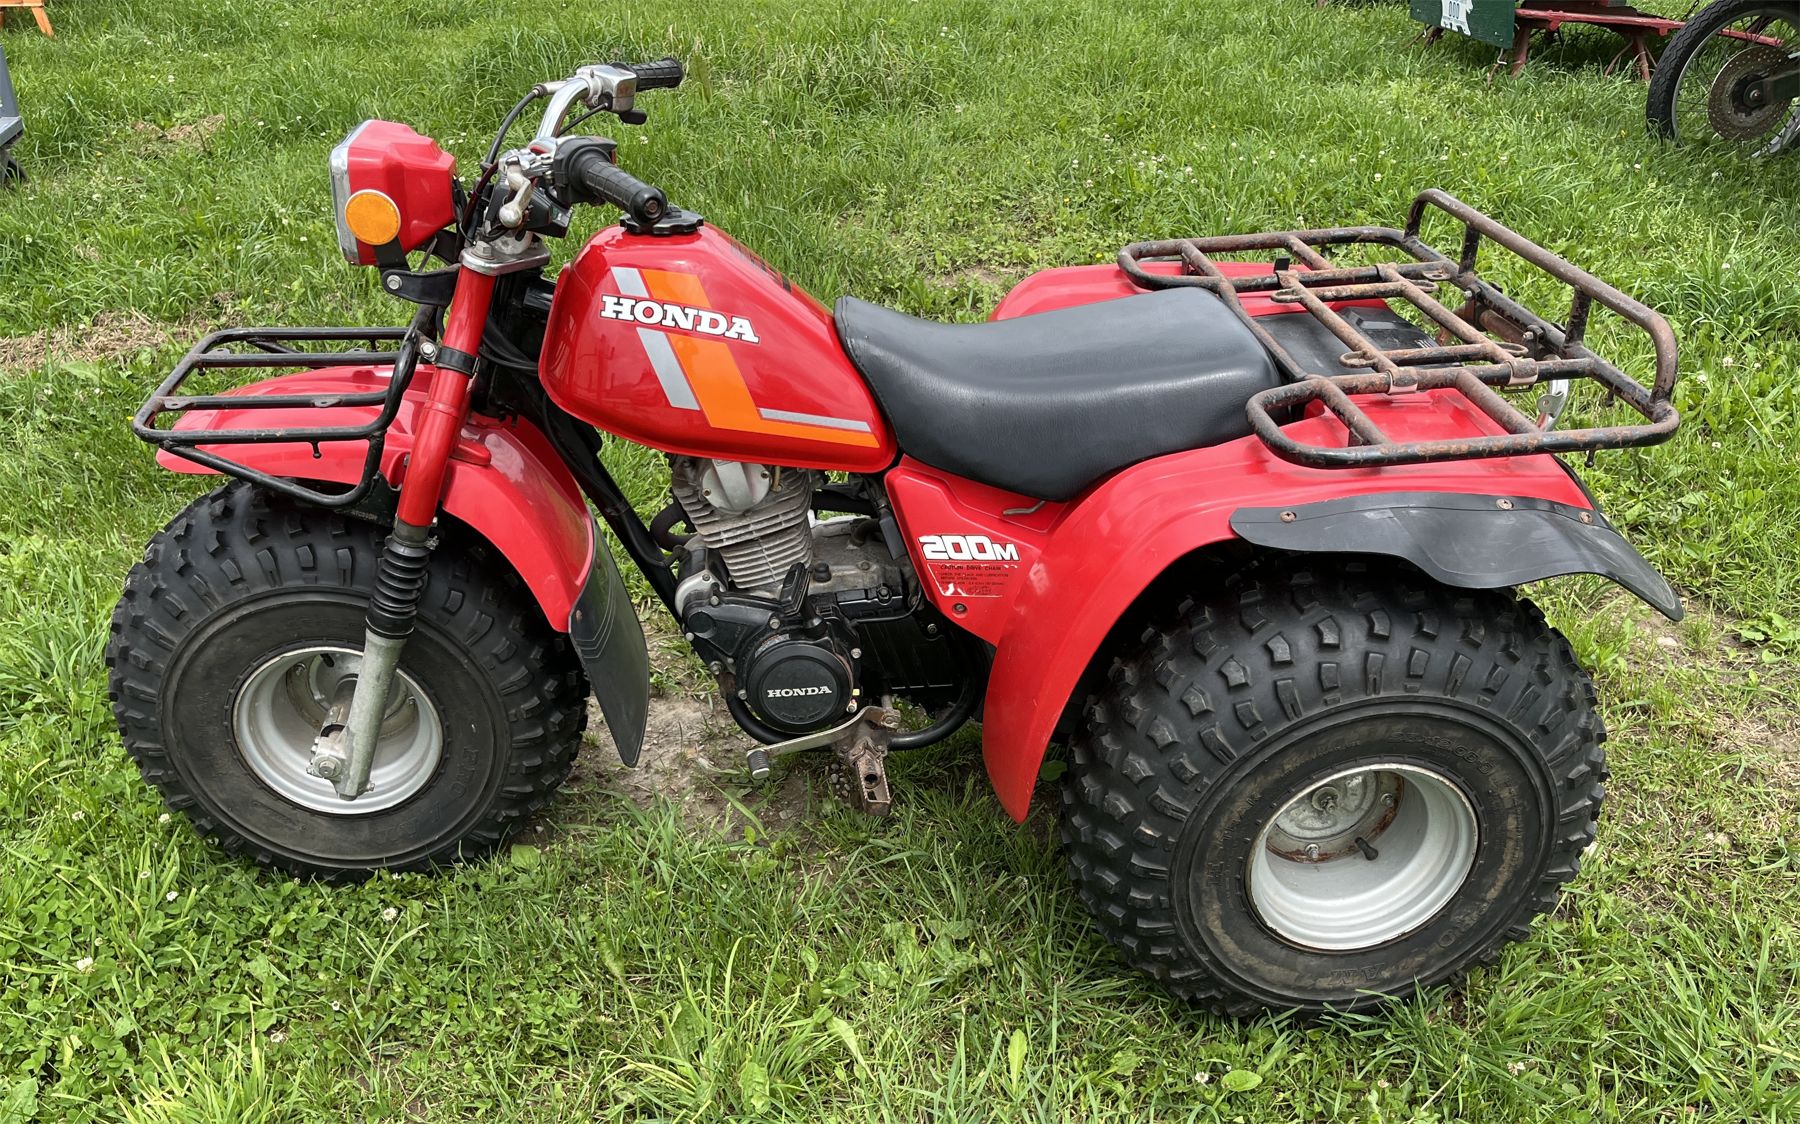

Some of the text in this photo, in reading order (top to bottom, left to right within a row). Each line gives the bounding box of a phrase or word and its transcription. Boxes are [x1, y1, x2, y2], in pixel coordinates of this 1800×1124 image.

[599, 294, 760, 345] HONDA
[918, 535, 1020, 561] 200M
[767, 685, 833, 698] HONDA
